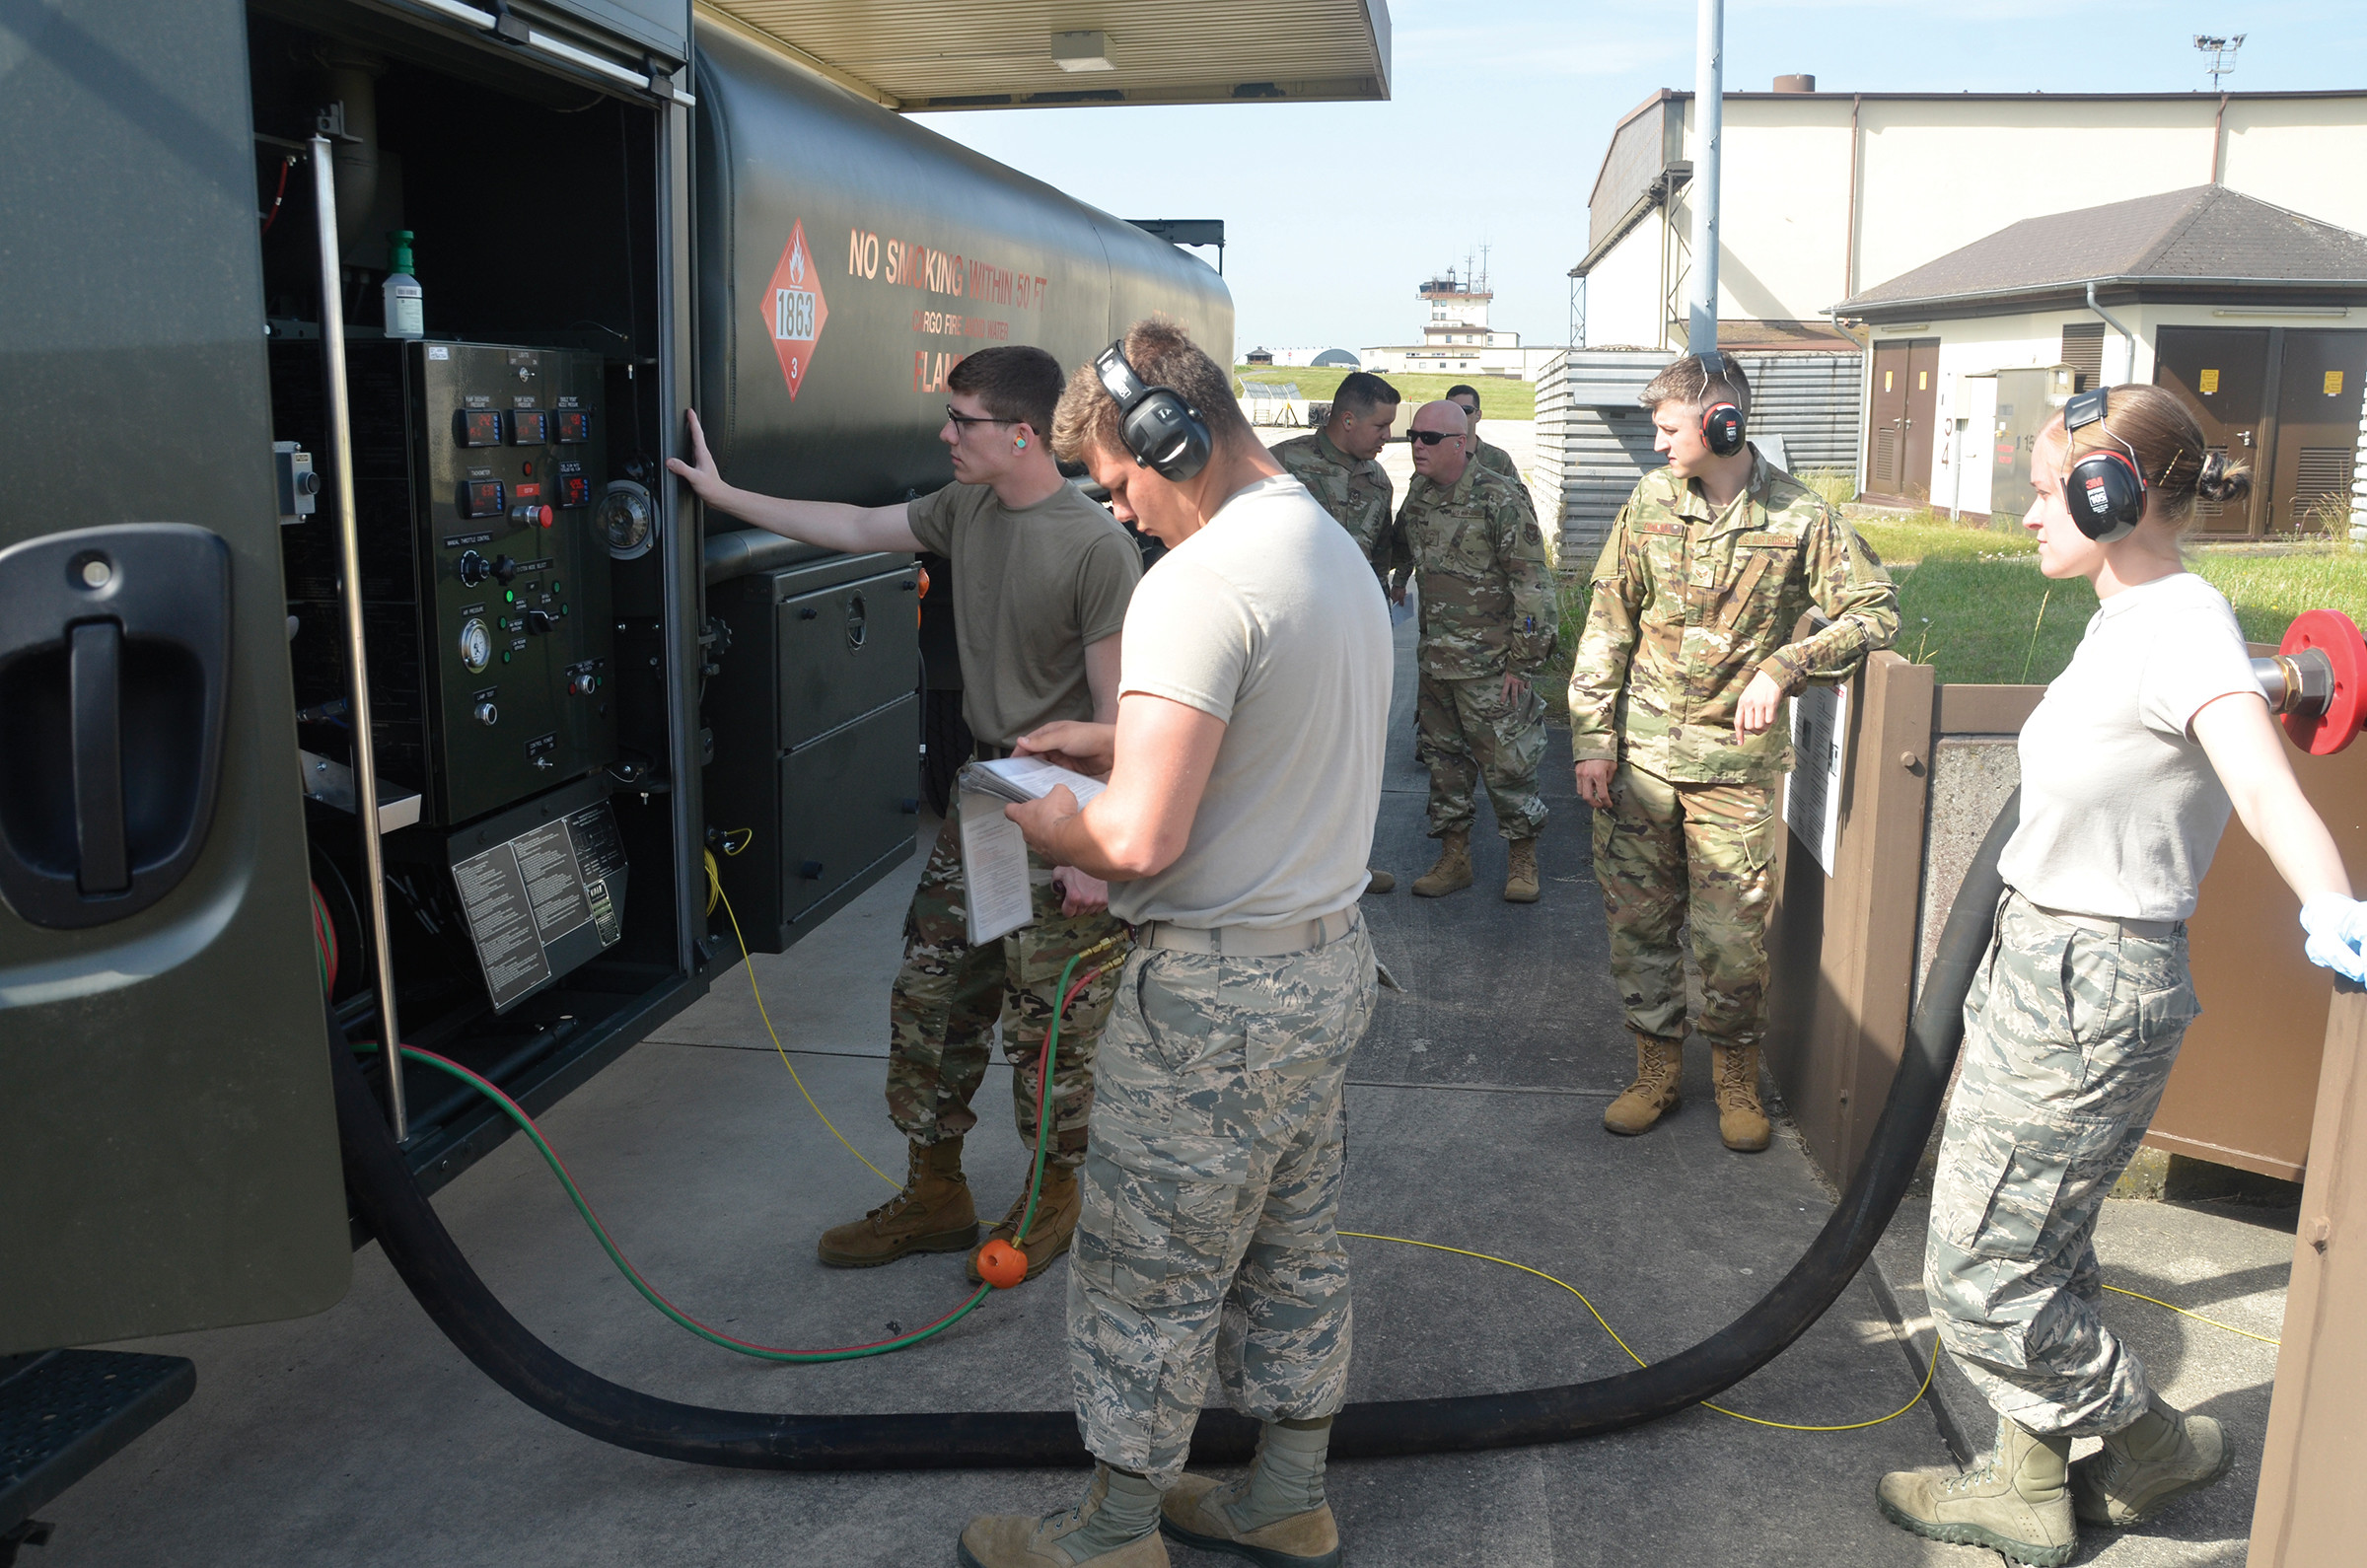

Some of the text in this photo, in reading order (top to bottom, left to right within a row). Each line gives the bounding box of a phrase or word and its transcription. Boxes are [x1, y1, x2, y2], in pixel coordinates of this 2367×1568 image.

[848, 226, 1047, 313] NO SMOKING WITHIN 50 FT
[778, 291, 814, 337] 1863
[912, 309, 1009, 341] CARGO FIRE AVOID WATER
[791, 357, 798, 379] 3
[913, 350, 966, 393] FLAM
[2086, 476, 2105, 489] 3M
[1752, 535, 1766, 545] AIR
[1766, 535, 1795, 546] FORCE
